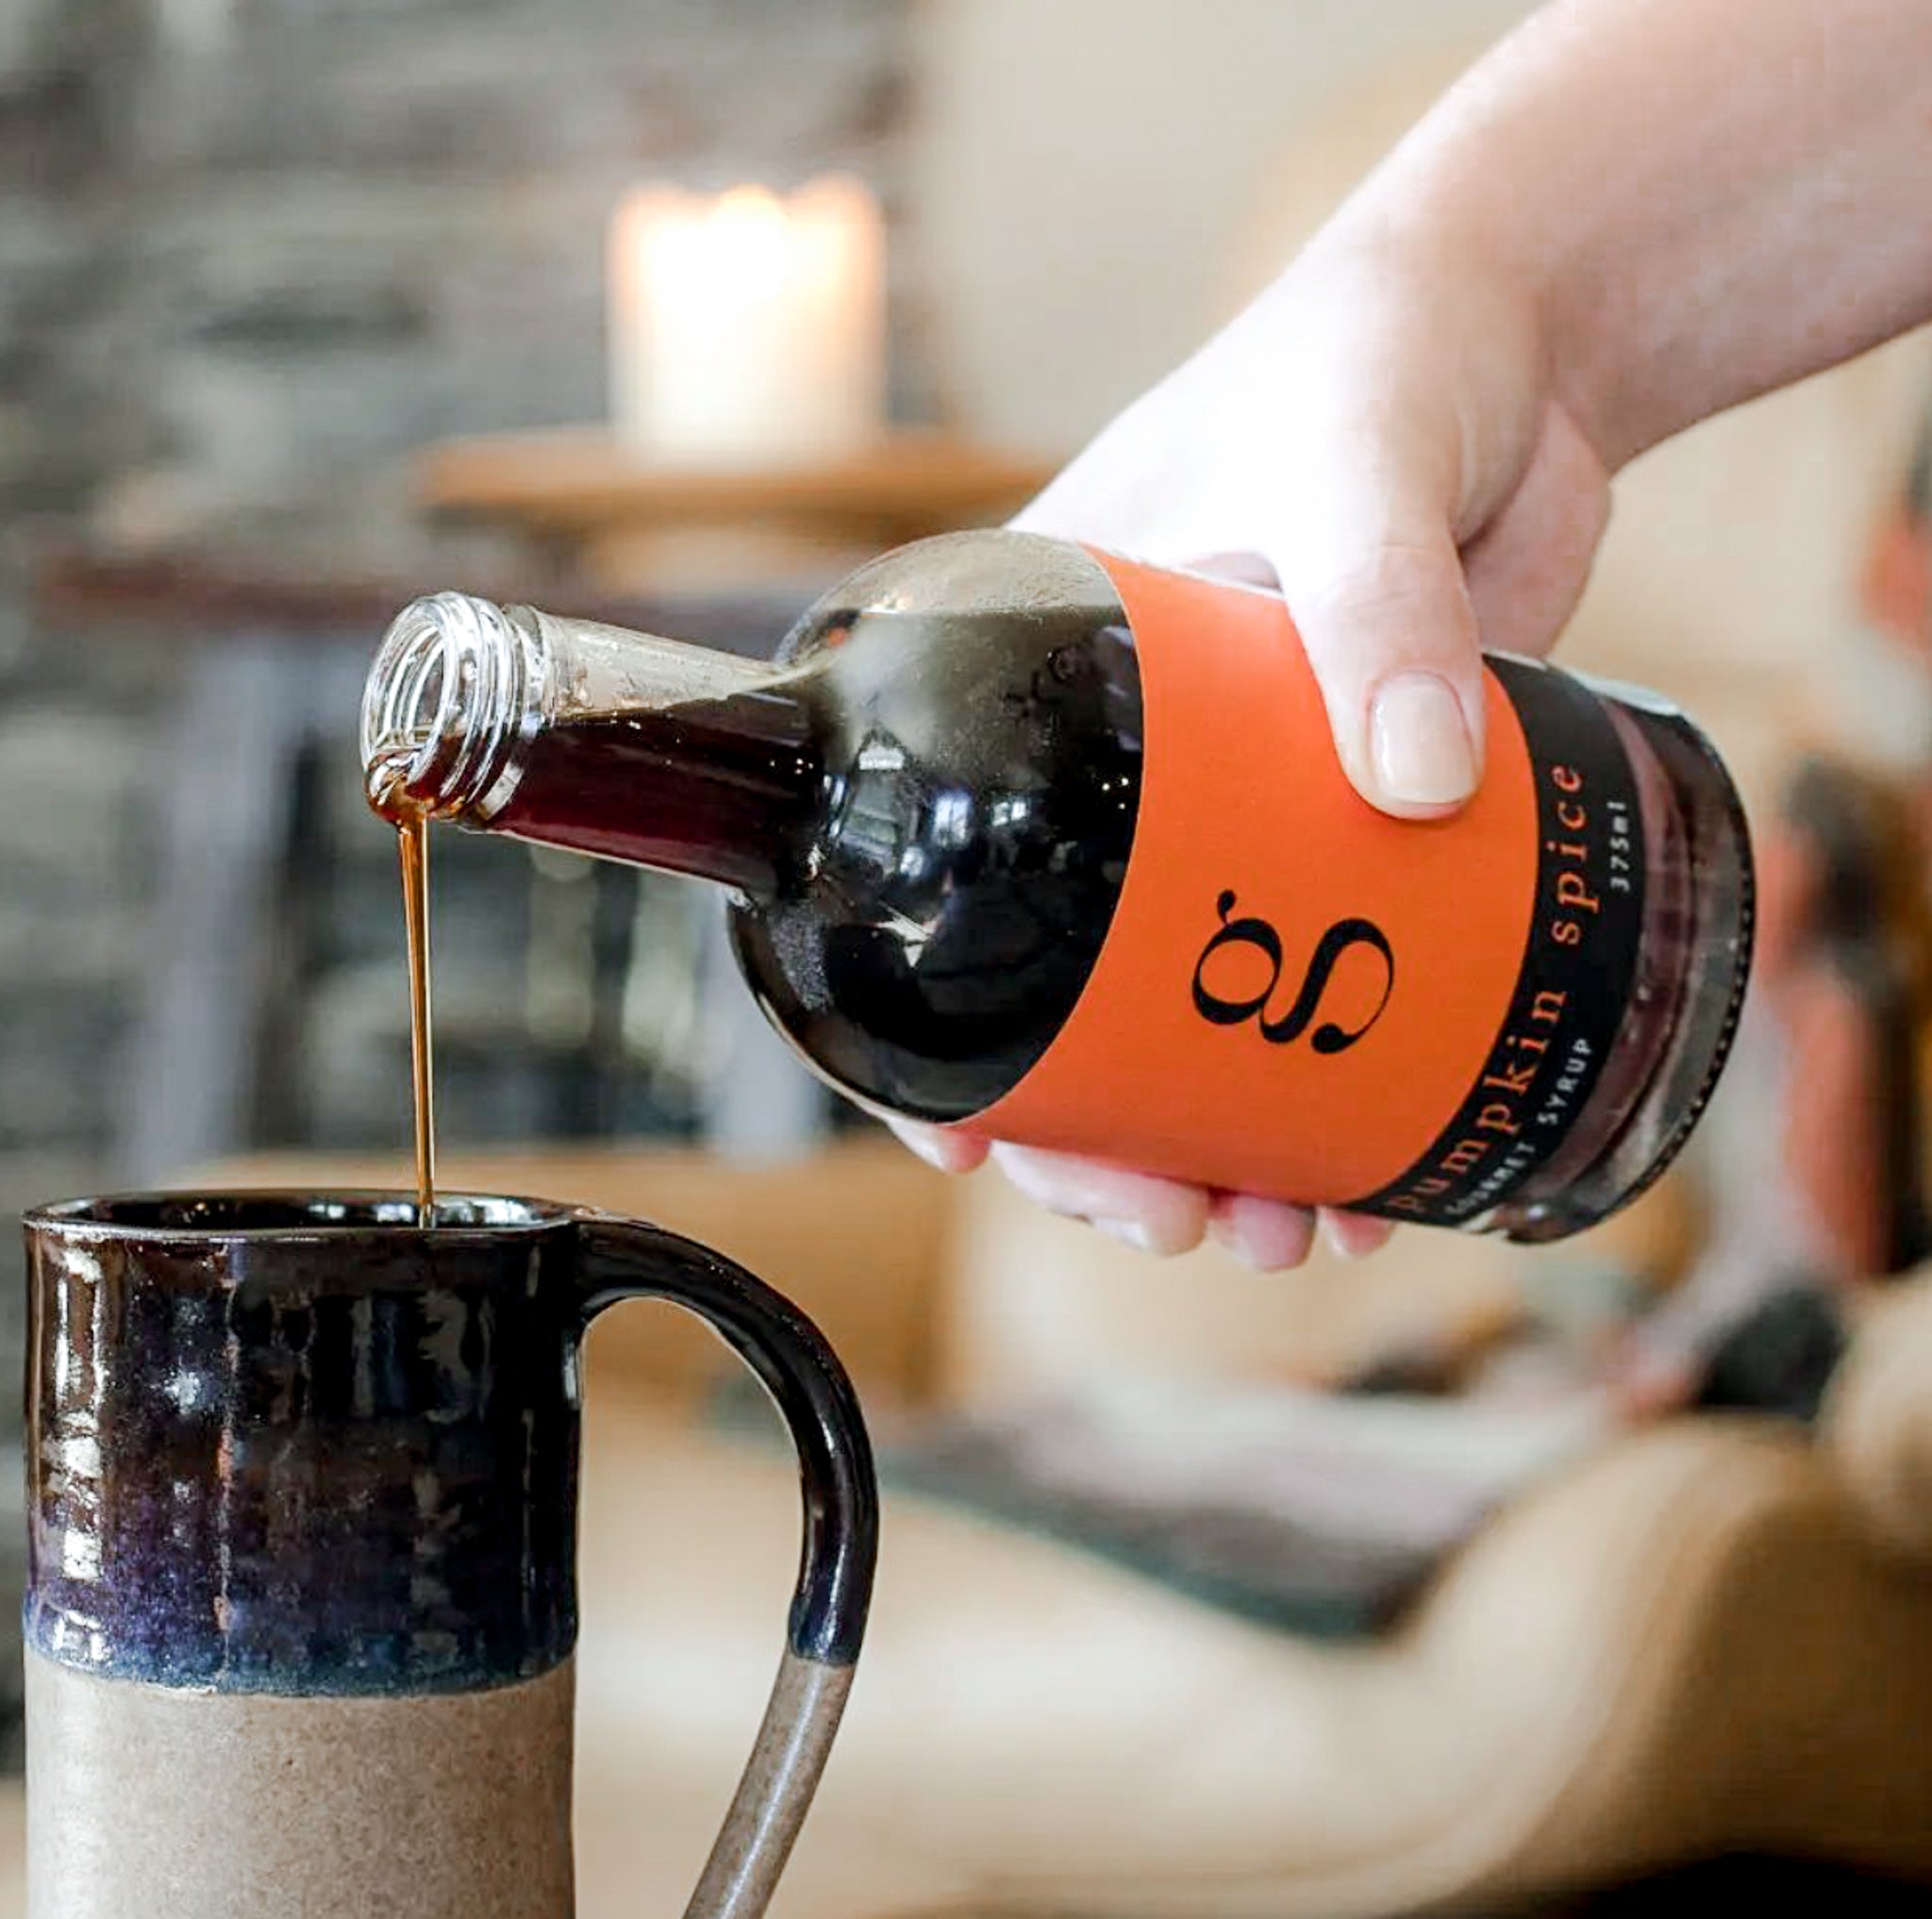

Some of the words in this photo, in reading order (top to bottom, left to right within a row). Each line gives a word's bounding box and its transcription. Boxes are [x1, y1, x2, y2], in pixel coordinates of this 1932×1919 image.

[1606, 801, 1631, 893] 375ml
[1191, 889, 1394, 1055] g
[1385, 990, 1569, 1213] pumpkin
[1544, 764, 1600, 945] spice
[1444, 1142, 1536, 1215] GOURMET
[1537, 1037, 1592, 1126] SYRUP
